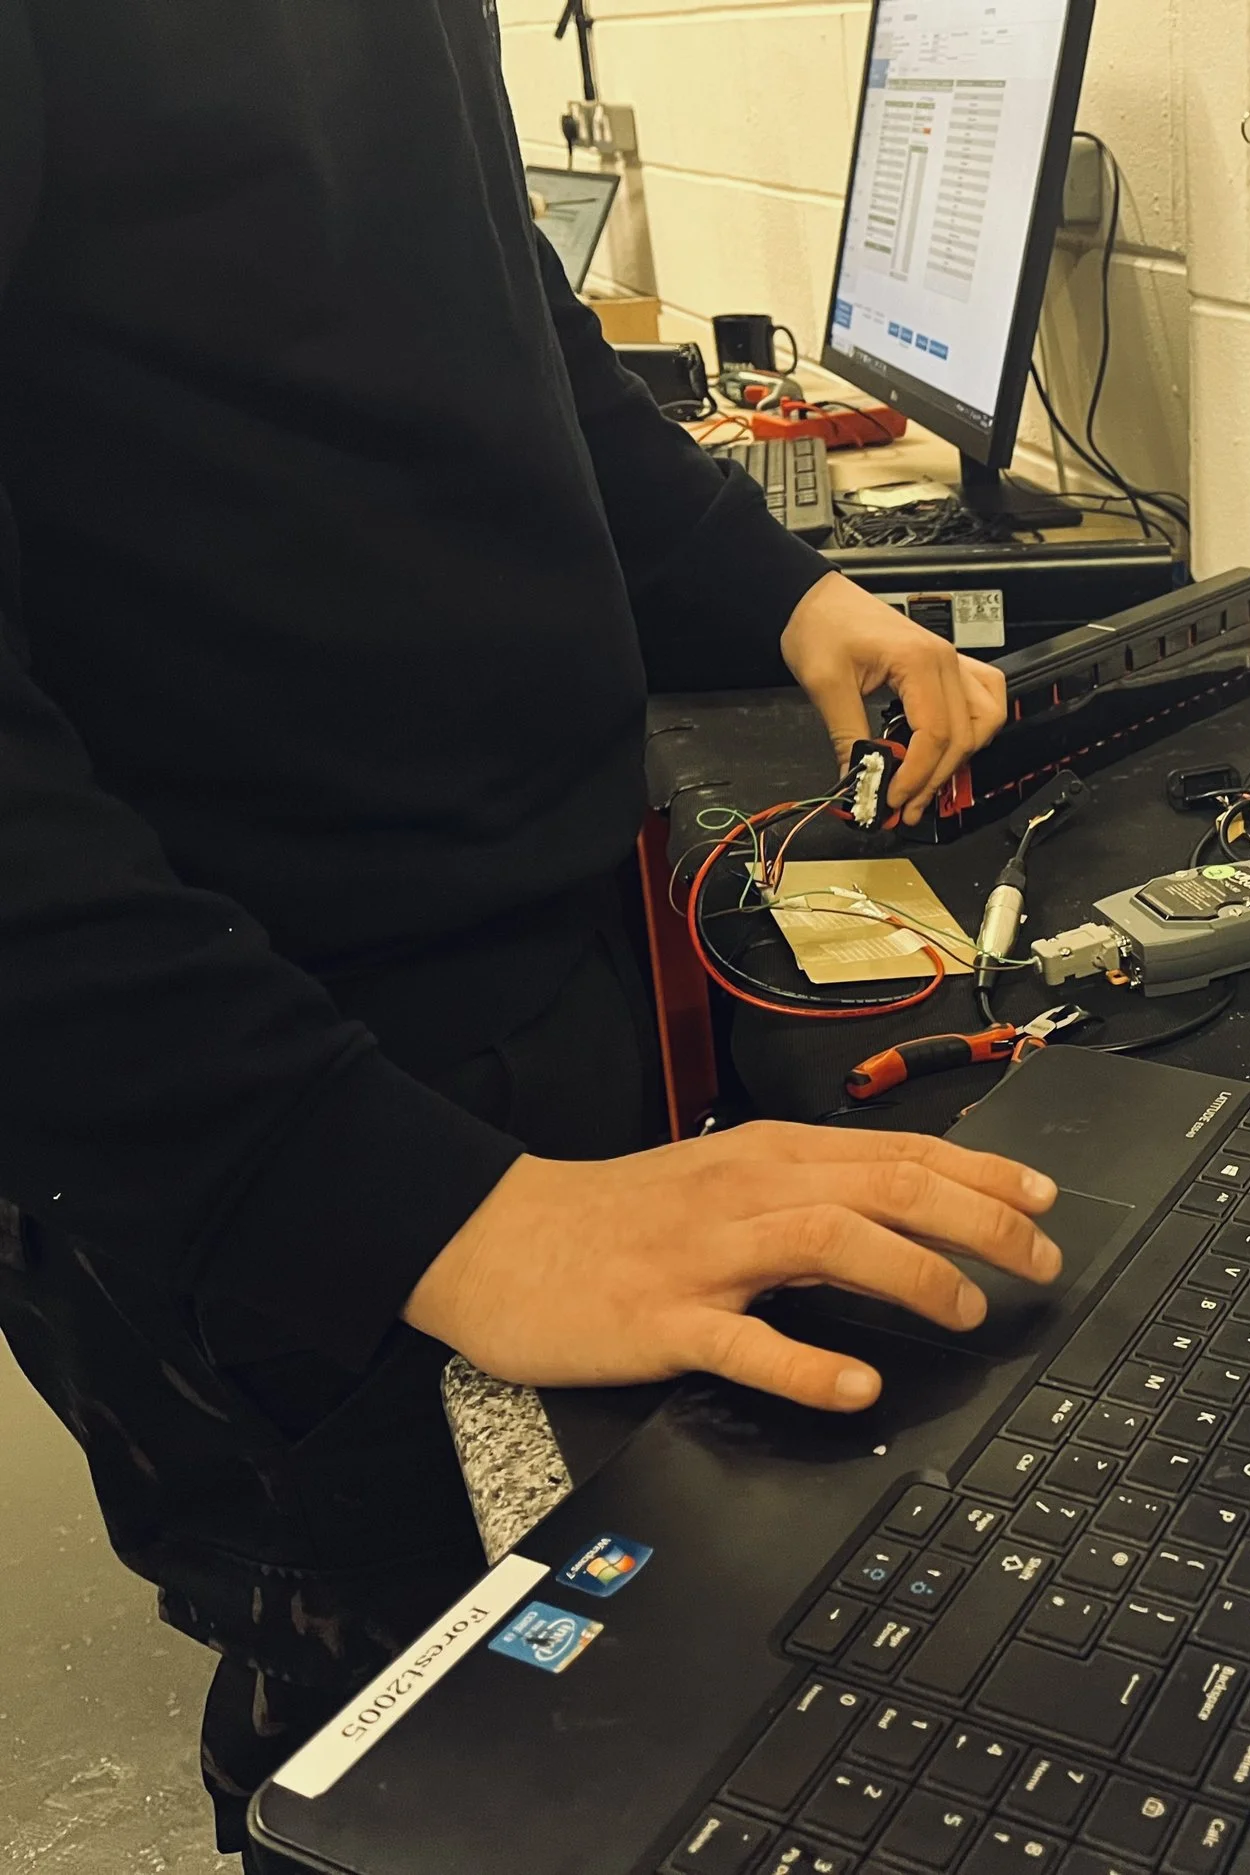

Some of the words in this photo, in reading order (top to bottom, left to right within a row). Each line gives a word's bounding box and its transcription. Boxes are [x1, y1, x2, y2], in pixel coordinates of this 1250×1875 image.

[1198, 1091, 1232, 1122] LATITUDE
[1216, 1192, 1229, 1203] Alt
[1224, 1268, 1241, 1278] V
[1200, 1300, 1217, 1310] B
[1173, 1336, 1192, 1349] N
[1225, 1370, 1240, 1380] J
[1144, 1374, 1166, 1390] M
[1058, 1399, 1074, 1413] Alt
[1051, 1412, 1065, 1424] Gr
[1197, 1412, 1216, 1424] K
[1016, 1453, 1034, 1471] Ctrl
[1170, 1455, 1189, 1464] L
[1219, 1509, 1236, 1523] P
[1018, 1557, 1042, 1580] Shift
[340, 1606, 491, 1743] Forest2005
[839, 1693, 856, 1706] 0
[1198, 1666, 1236, 1721] Backspace
[878, 1708, 897, 1729] End
[912, 1720, 928, 1729] 1
[986, 1743, 1003, 1756] 4
[1067, 1771, 1084, 1784] 7
[863, 1785, 882, 1799] 2
[943, 1813, 962, 1826] 5
[1024, 1841, 1043, 1857] 8
[814, 1859, 833, 1873] 3
